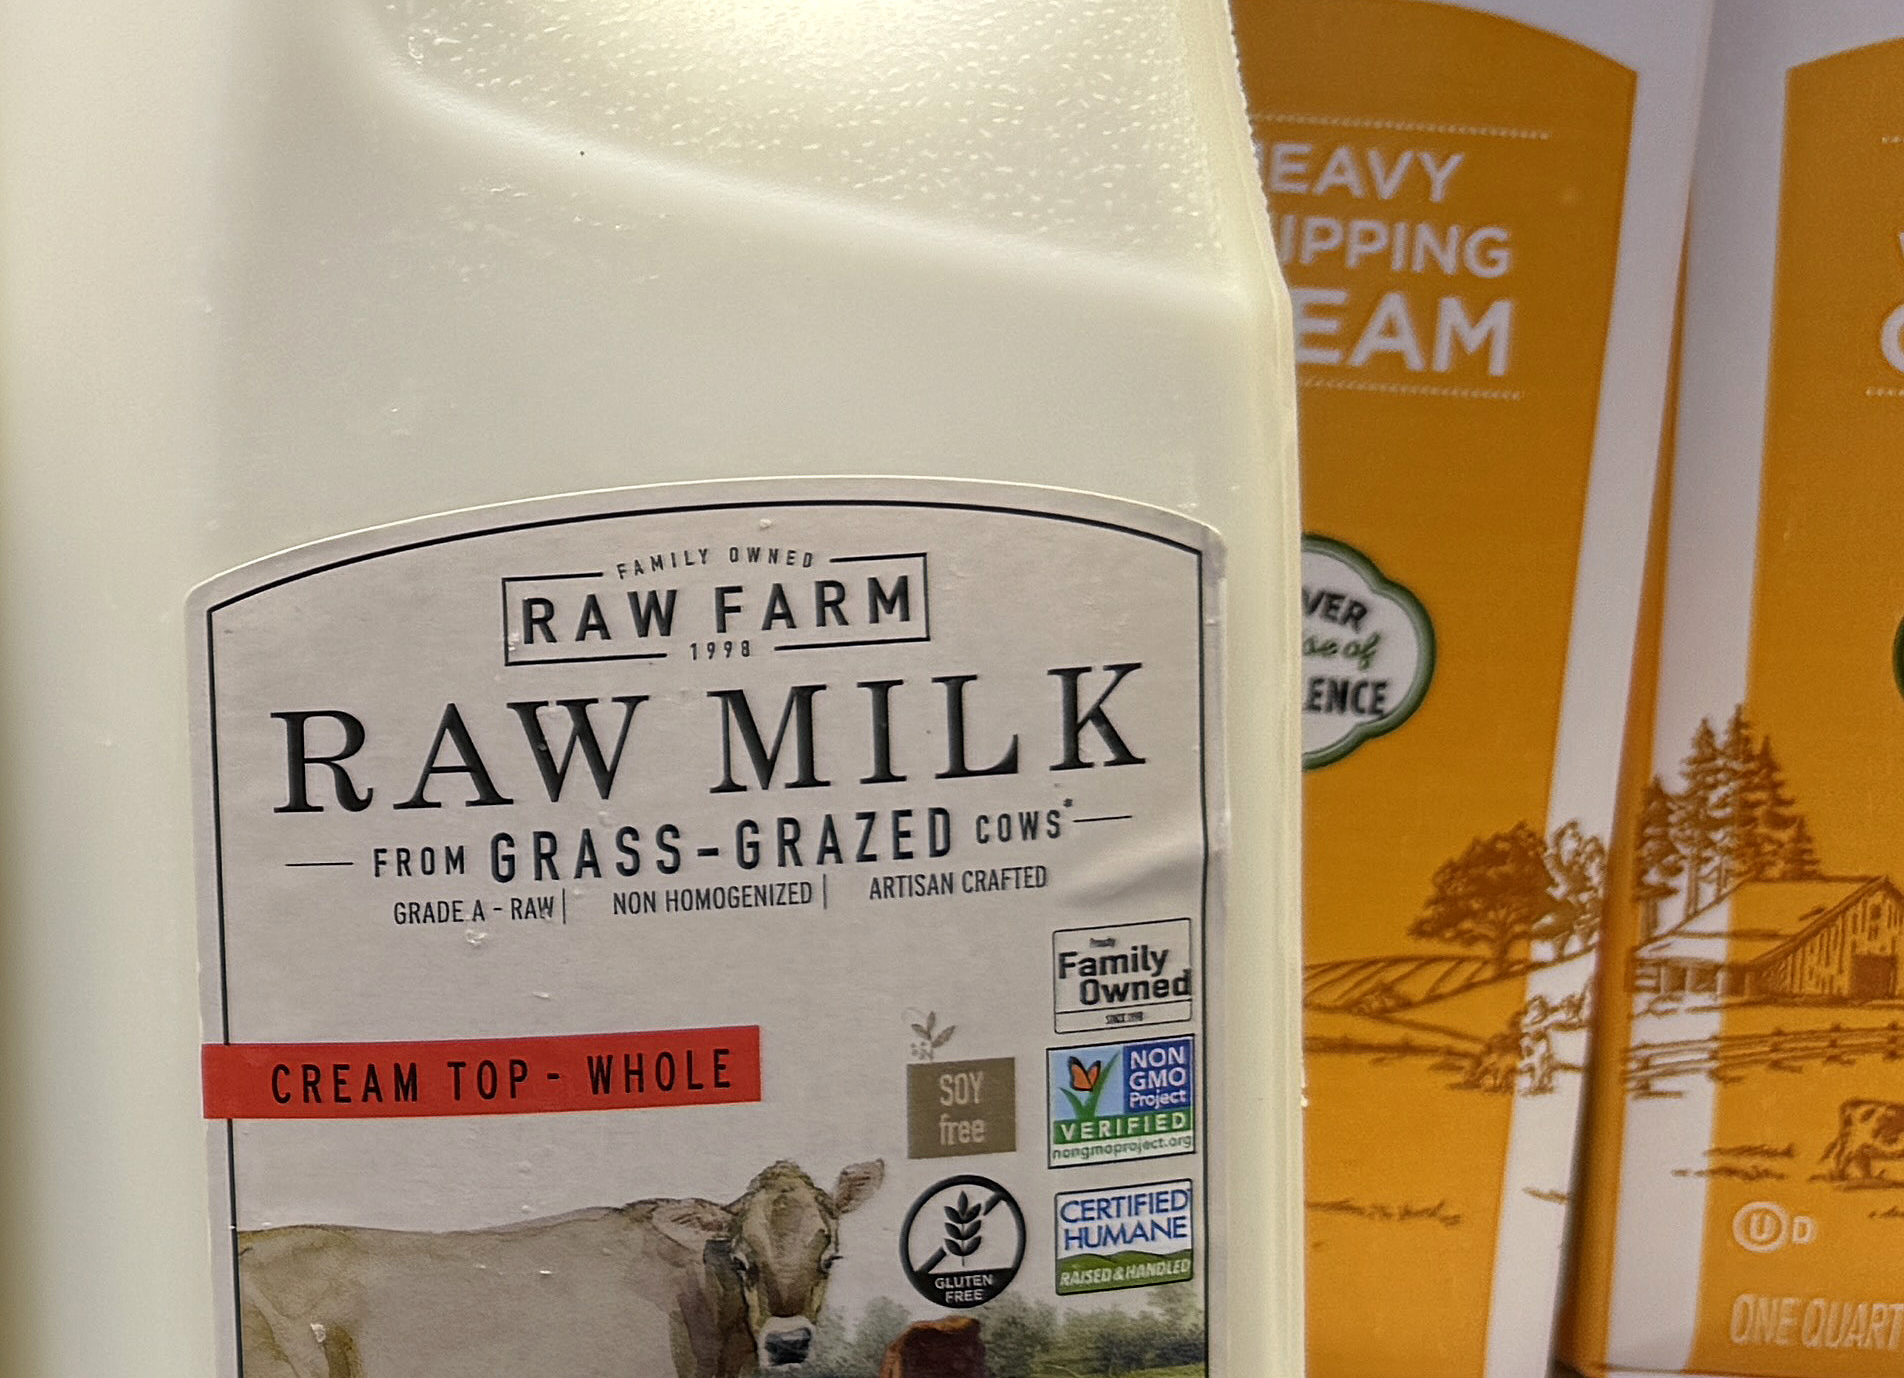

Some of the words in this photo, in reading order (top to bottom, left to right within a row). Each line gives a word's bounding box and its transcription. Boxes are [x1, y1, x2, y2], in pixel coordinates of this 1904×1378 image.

[1280, 214, 1512, 278] IPPING
[522, 589, 677, 645] RAW
[714, 575, 910, 633] FARM
[270, 695, 649, 813] RAW
[707, 662, 1146, 794] MILK
[491, 807, 950, 883] GRASS-GRAZED
[869, 869, 954, 900] ARTISAN
[962, 866, 1047, 894] CRAFTED
[271, 1063, 418, 1104] CREAM
[448, 1059, 528, 1101] TOP
[588, 1048, 731, 1096] WHOLE
[1731, 1295, 1794, 1345] ONE
